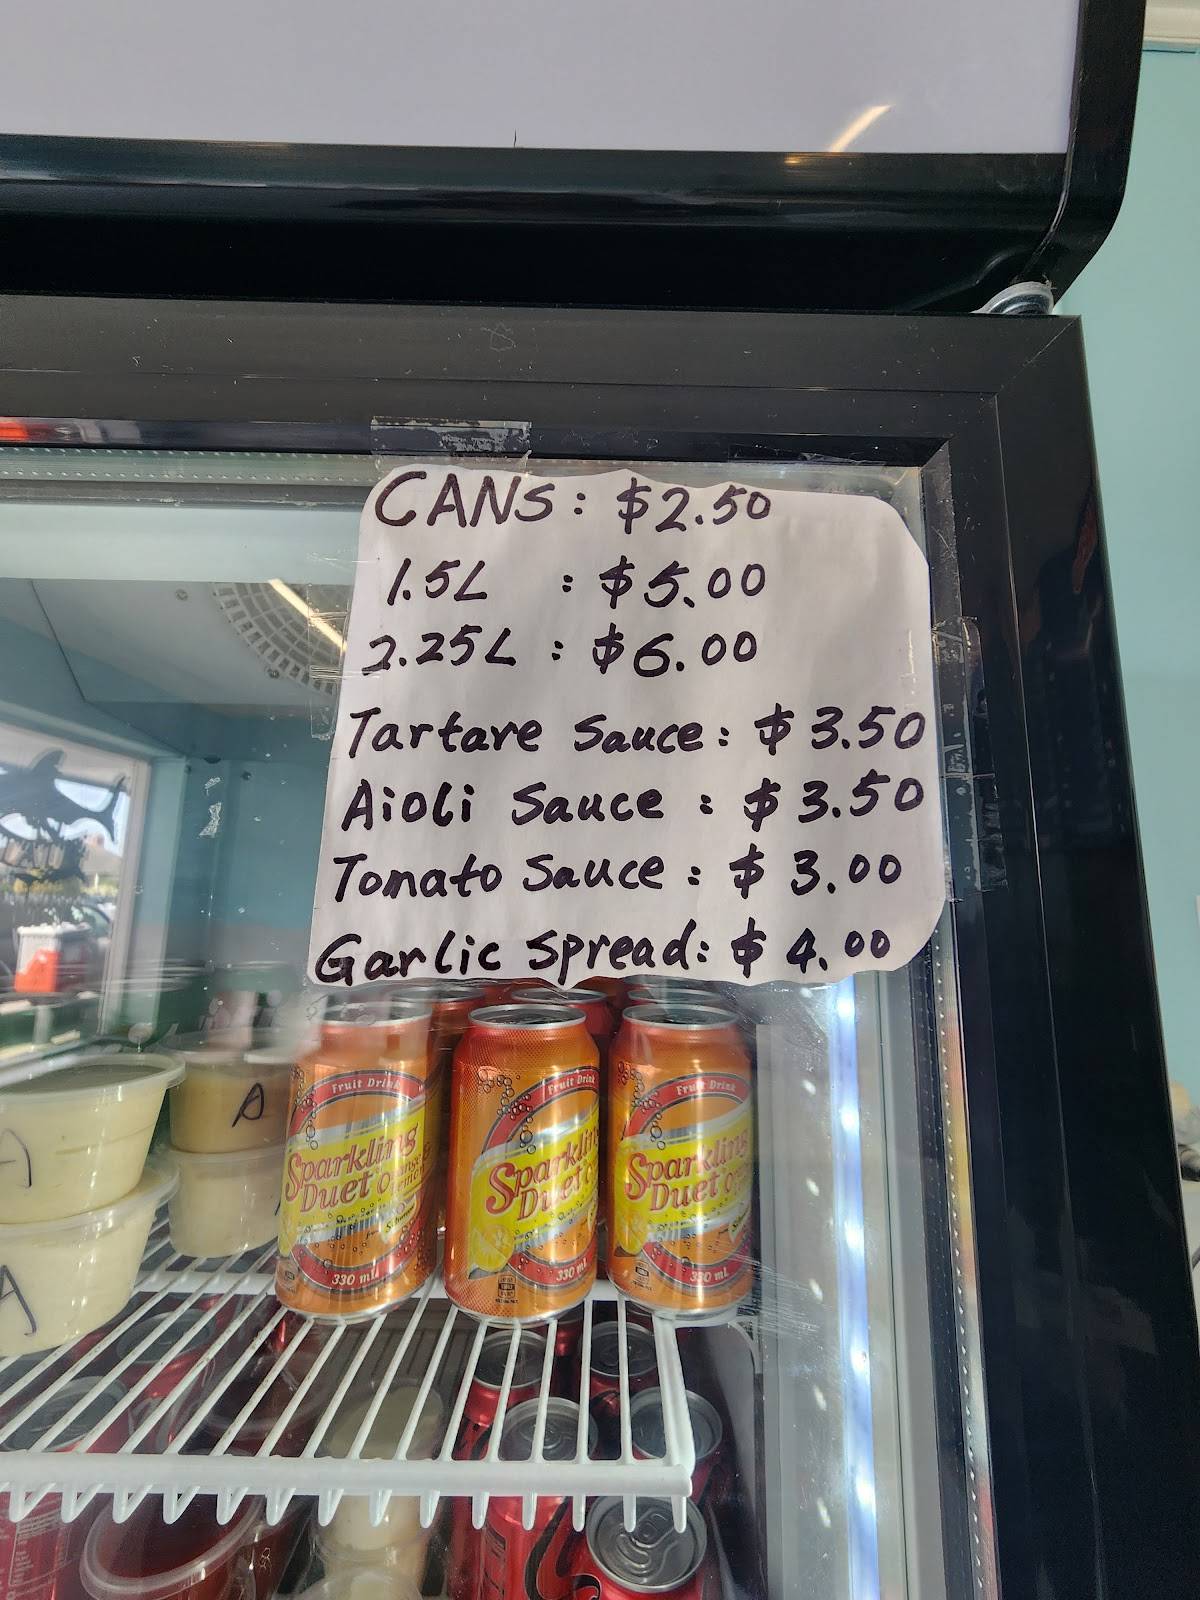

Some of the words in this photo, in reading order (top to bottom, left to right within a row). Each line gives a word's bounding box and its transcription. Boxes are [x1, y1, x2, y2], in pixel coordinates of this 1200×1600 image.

[616, 476, 771, 534] $2.50
[387, 558, 488, 606] 1.5L
[598, 555, 766, 609] $5.00
[361, 624, 517, 676] 2.25L
[592, 623, 758, 677] $6.00
[348, 707, 543, 758] Tartare
[340, 779, 475, 831] Aioli
[332, 853, 503, 903] Tomato
[314, 929, 502, 987] Garlic
[331, 1080, 364, 1095] Fruit
[547, 1077, 574, 1096] Fruit
[676, 1080, 705, 1096] Fru
[285, 1122, 419, 1204] Sparkling
[486, 1128, 599, 1215] Sparklin
[624, 1130, 749, 1201] Sparkling
[300, 1169, 374, 1215] Duet
[650, 1171, 720, 1212] Duet
[331, 1273, 355, 1286] 330
[556, 1266, 575, 1281] 330
